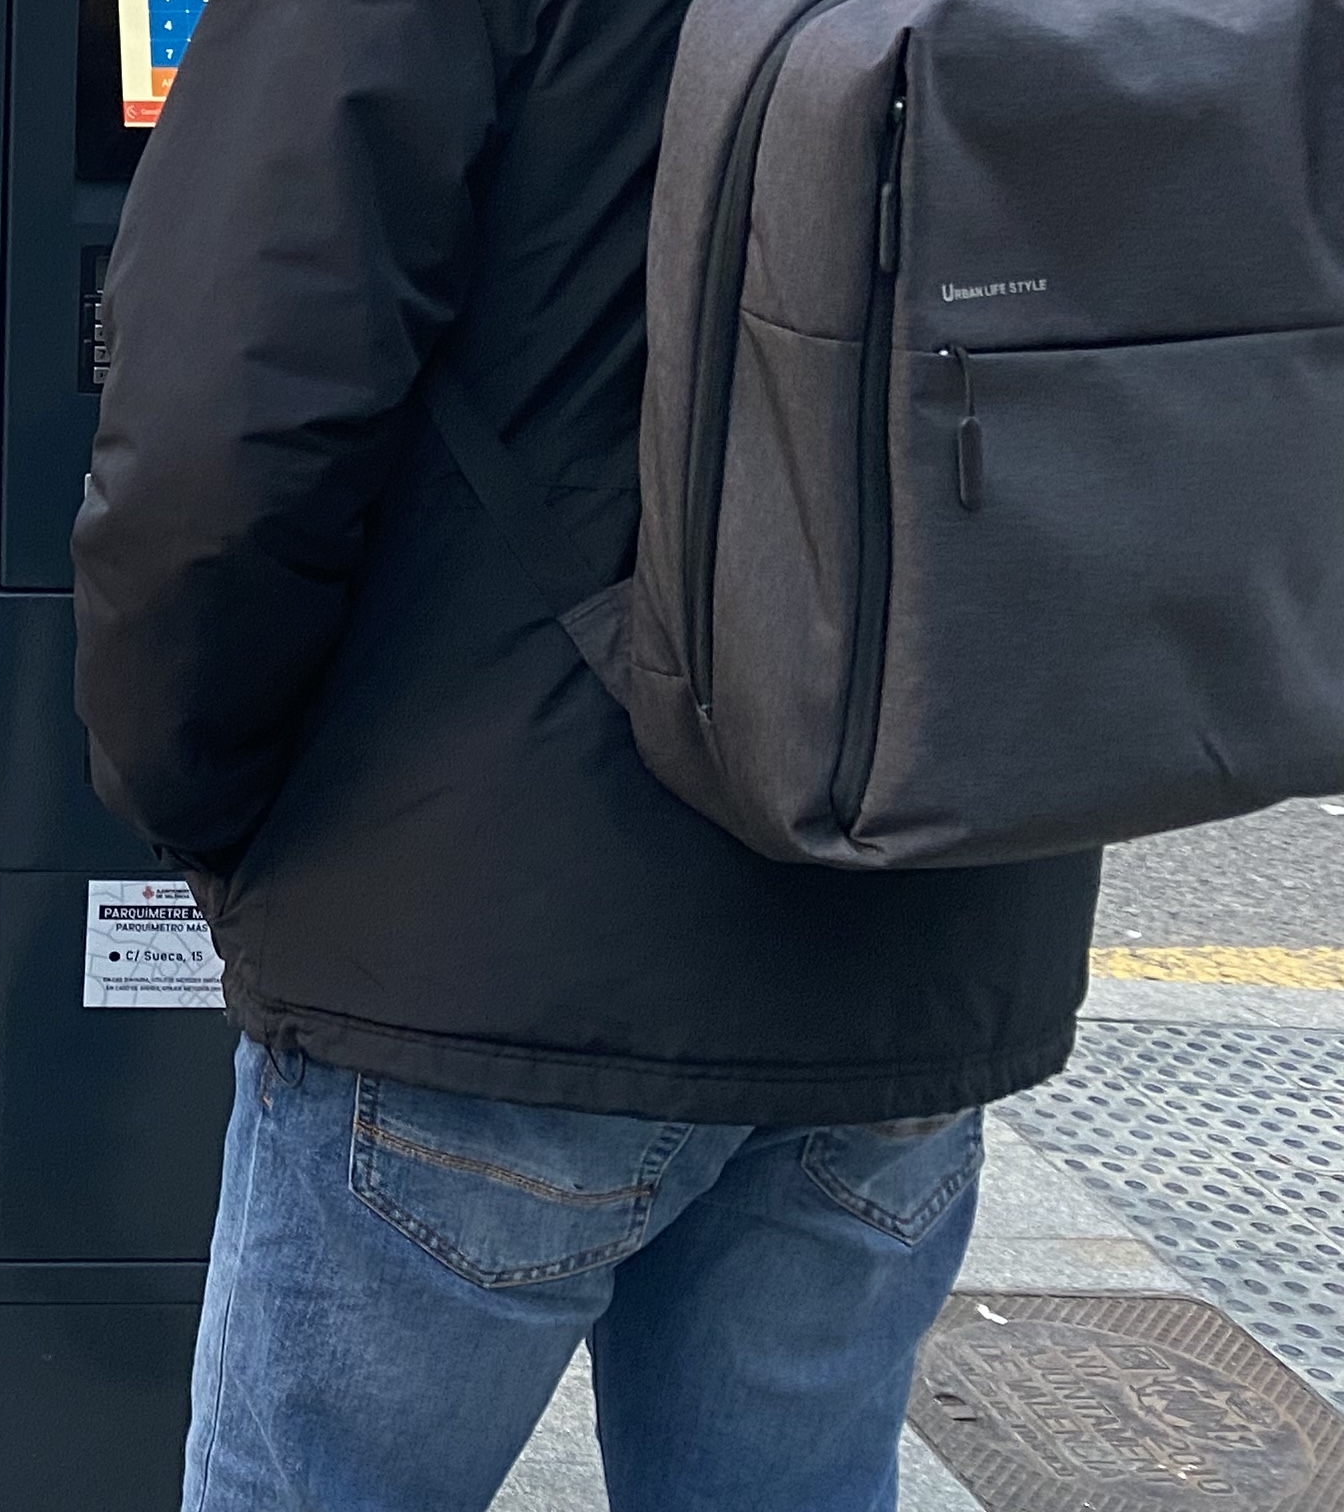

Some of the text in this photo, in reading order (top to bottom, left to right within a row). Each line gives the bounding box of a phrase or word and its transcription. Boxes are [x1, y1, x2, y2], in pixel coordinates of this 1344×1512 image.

[164, 20, 173, 31] 4
[165, 49, 174, 60] 7
[1008, 279, 1048, 294] STYLE
[104, 907, 189, 920] PARQUÍMETRE
[116, 922, 208, 933] PARQUÍMETRO MÁS
[125, 949, 203, 963] C/ Sueca, 15
